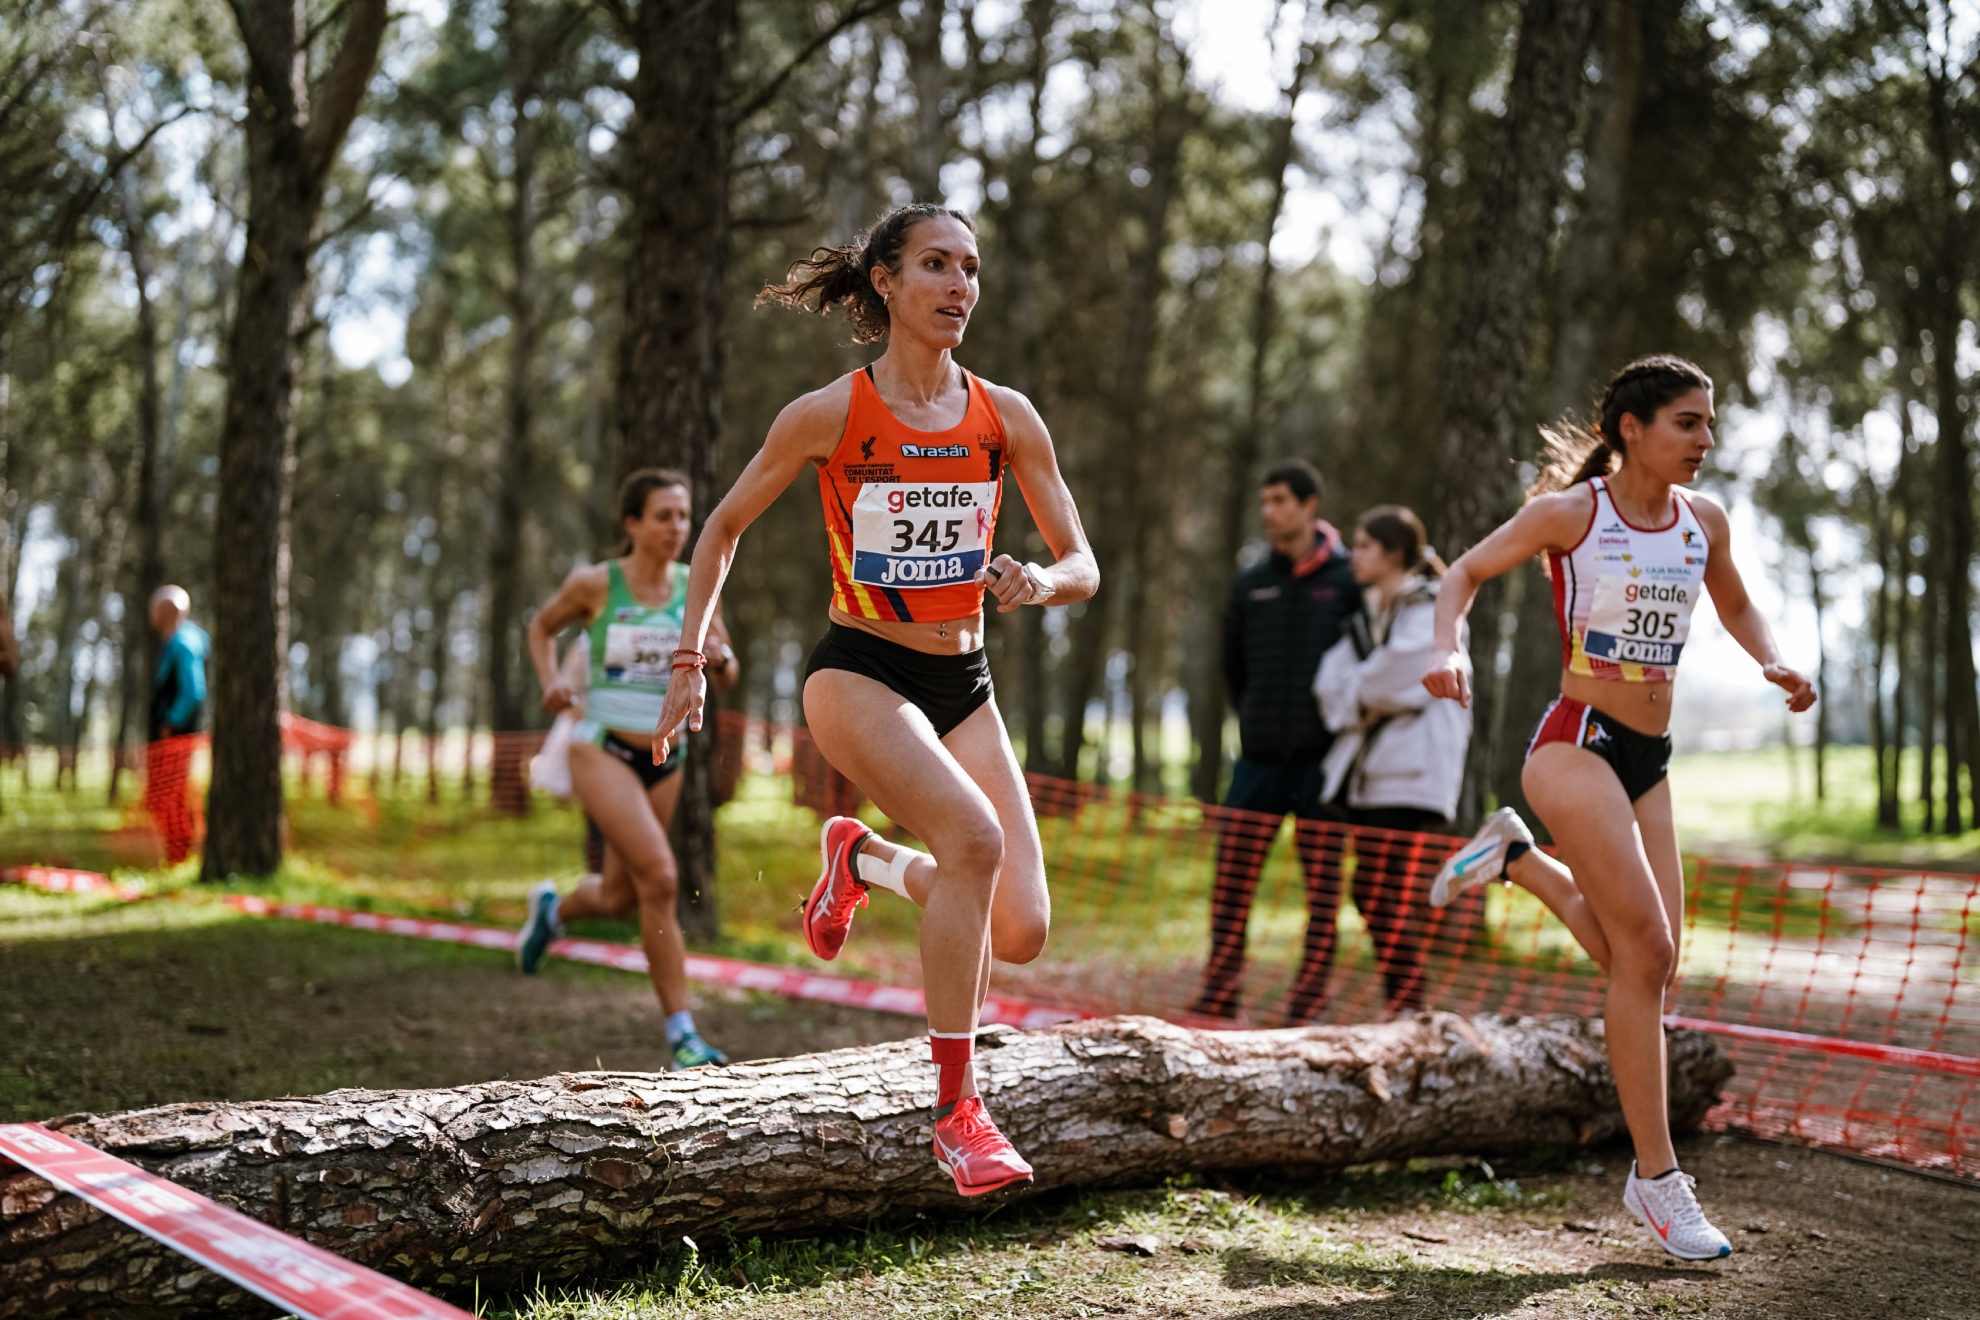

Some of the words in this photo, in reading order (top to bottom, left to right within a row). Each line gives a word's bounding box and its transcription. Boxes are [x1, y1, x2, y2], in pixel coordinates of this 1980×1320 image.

[844, 468, 894, 476] COMUNITAT
[891, 520, 963, 553] 345
[1622, 609, 1678, 640] 305
